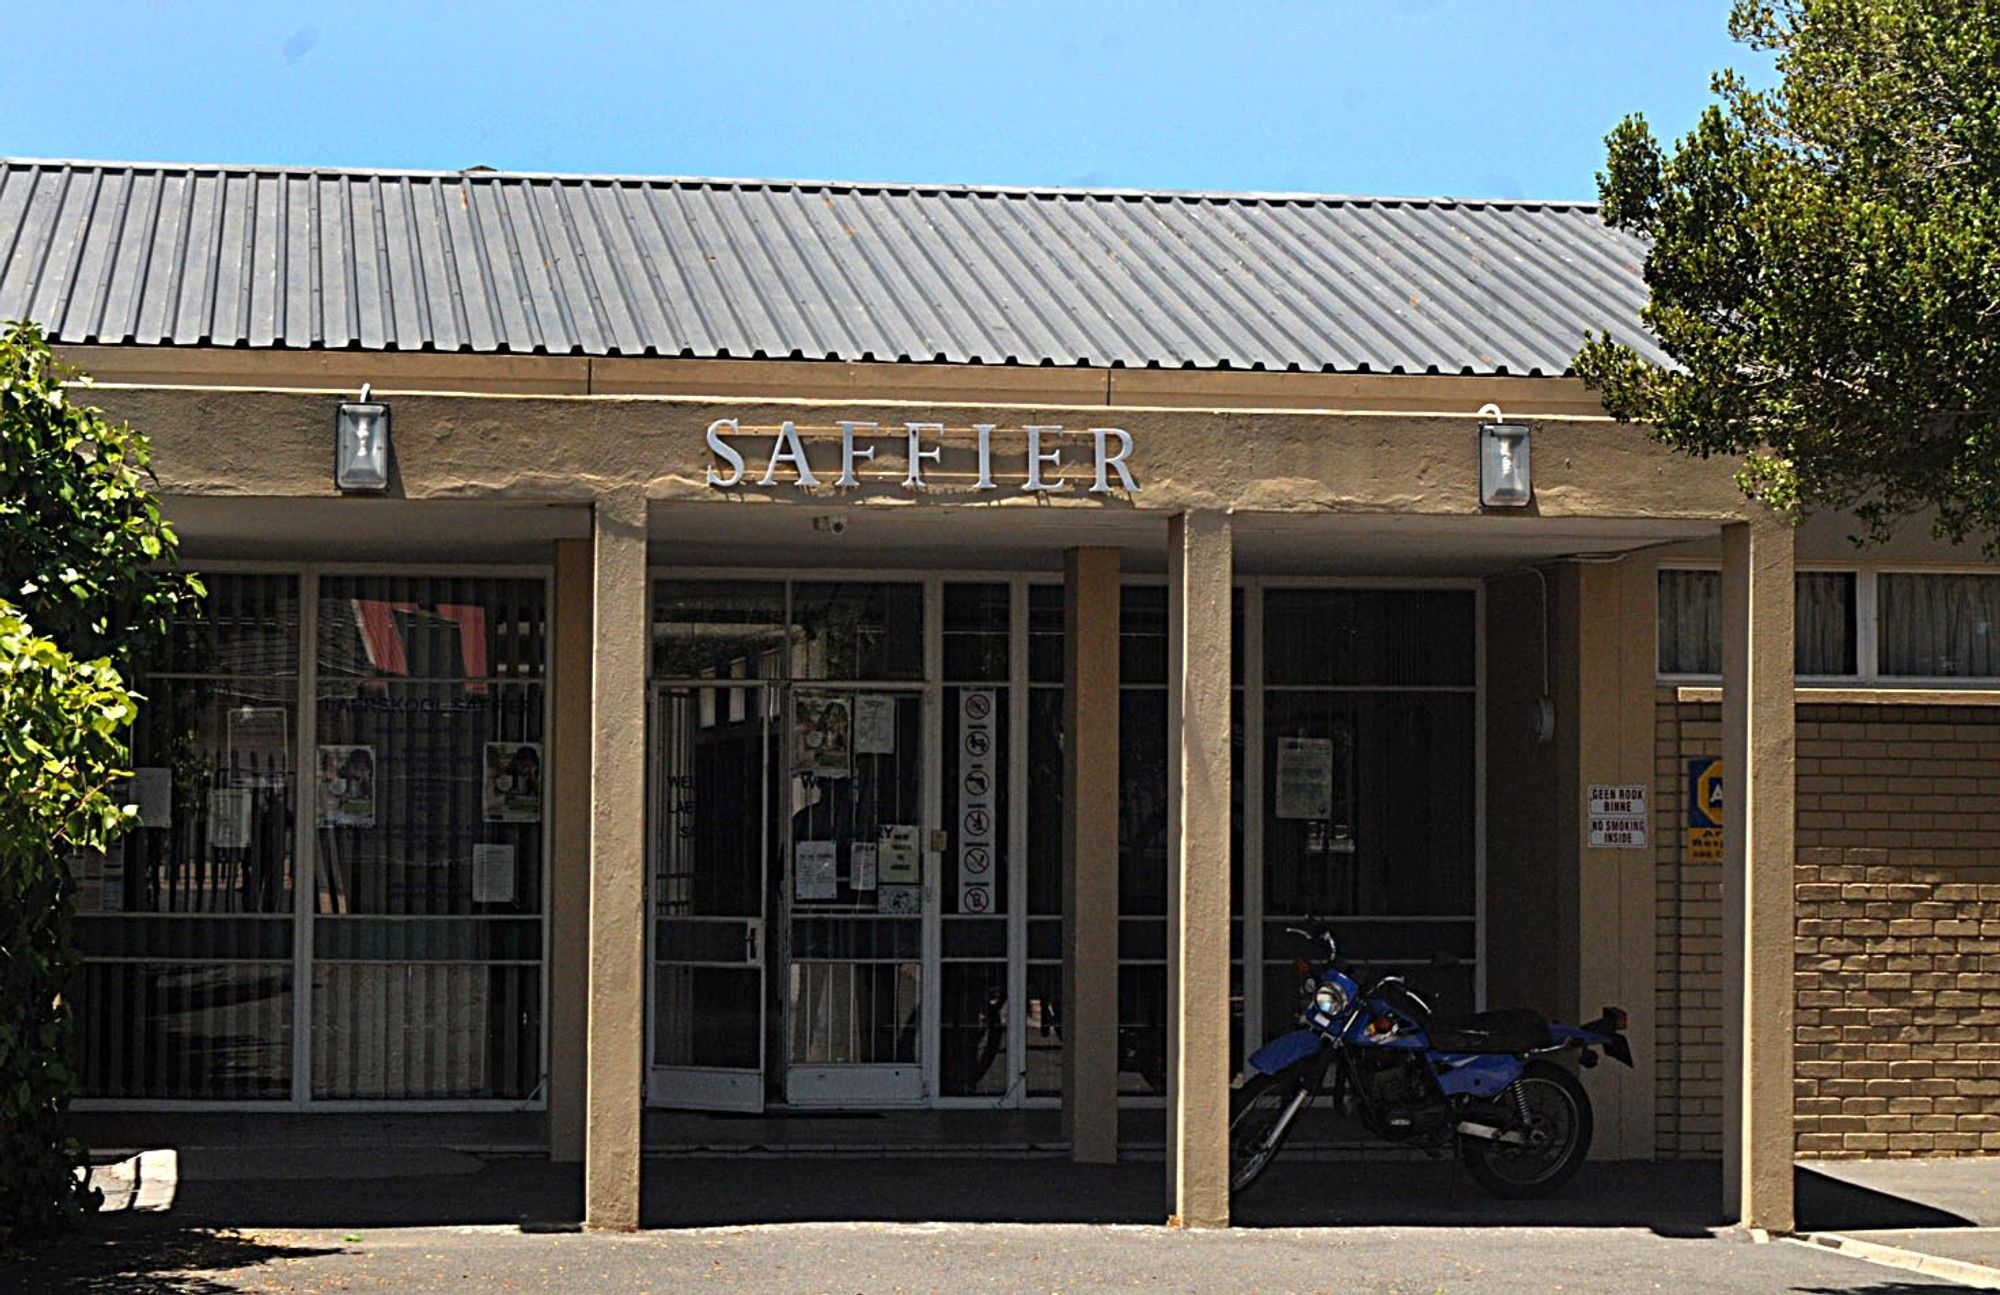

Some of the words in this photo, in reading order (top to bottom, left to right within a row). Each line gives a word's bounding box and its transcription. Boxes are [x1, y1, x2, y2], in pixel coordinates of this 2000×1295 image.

[706, 417, 1143, 492] SAFFIER
[1592, 789, 1616, 800] GEEN
[1619, 789, 1643, 800] ROOK
[1604, 801, 1632, 812] BINNE
[1592, 820, 1604, 831] NO
[1605, 820, 1645, 831] SMOKING
[1604, 832, 1632, 844] INSIDE
